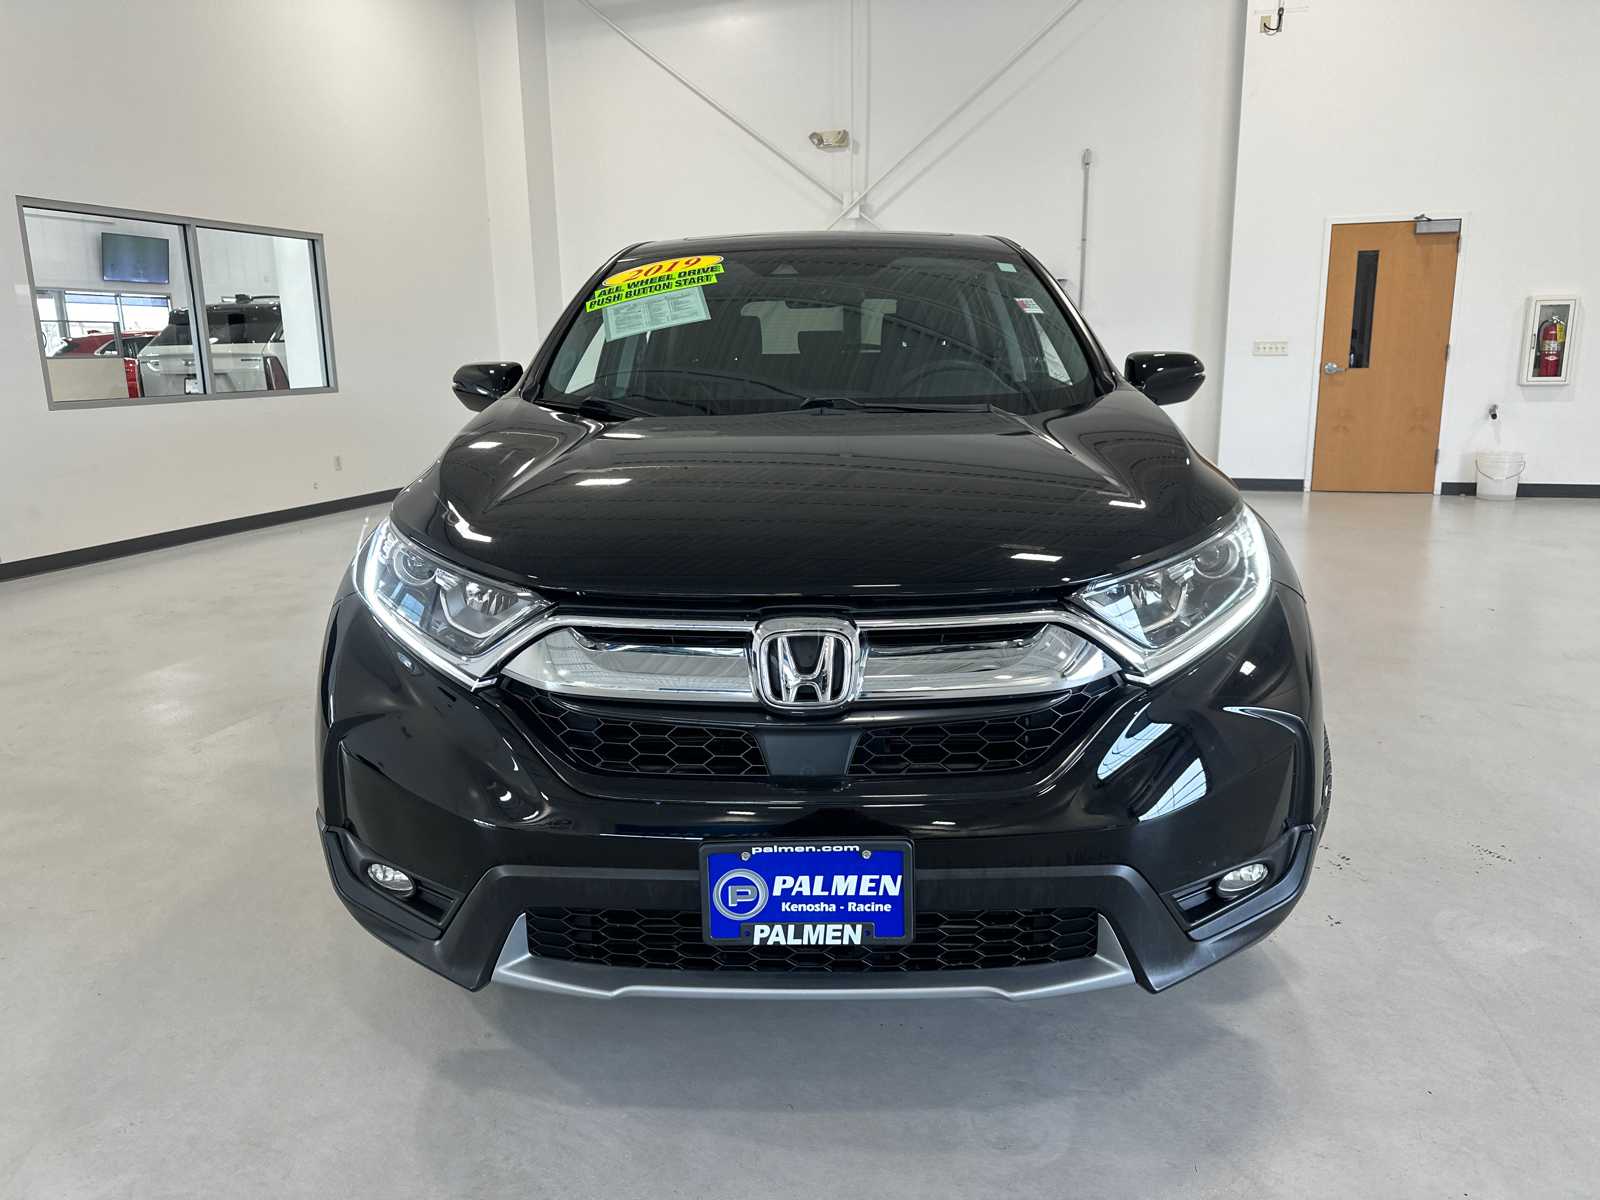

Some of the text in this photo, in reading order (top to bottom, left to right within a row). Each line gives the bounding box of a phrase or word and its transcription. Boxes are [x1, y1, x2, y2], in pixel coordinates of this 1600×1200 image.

[622, 257, 702, 283] 2019
[589, 274, 713, 309] PUSH BUTTON START
[597, 265, 721, 298] ALL WHEEL DRIVE
[751, 845, 860, 854] palmen.com
[728, 885, 758, 907] P
[772, 875, 902, 896] PALMEN
[781, 902, 836, 912] Kenosha
[847, 902, 892, 912] Racine
[753, 924, 862, 945] PALMEN
